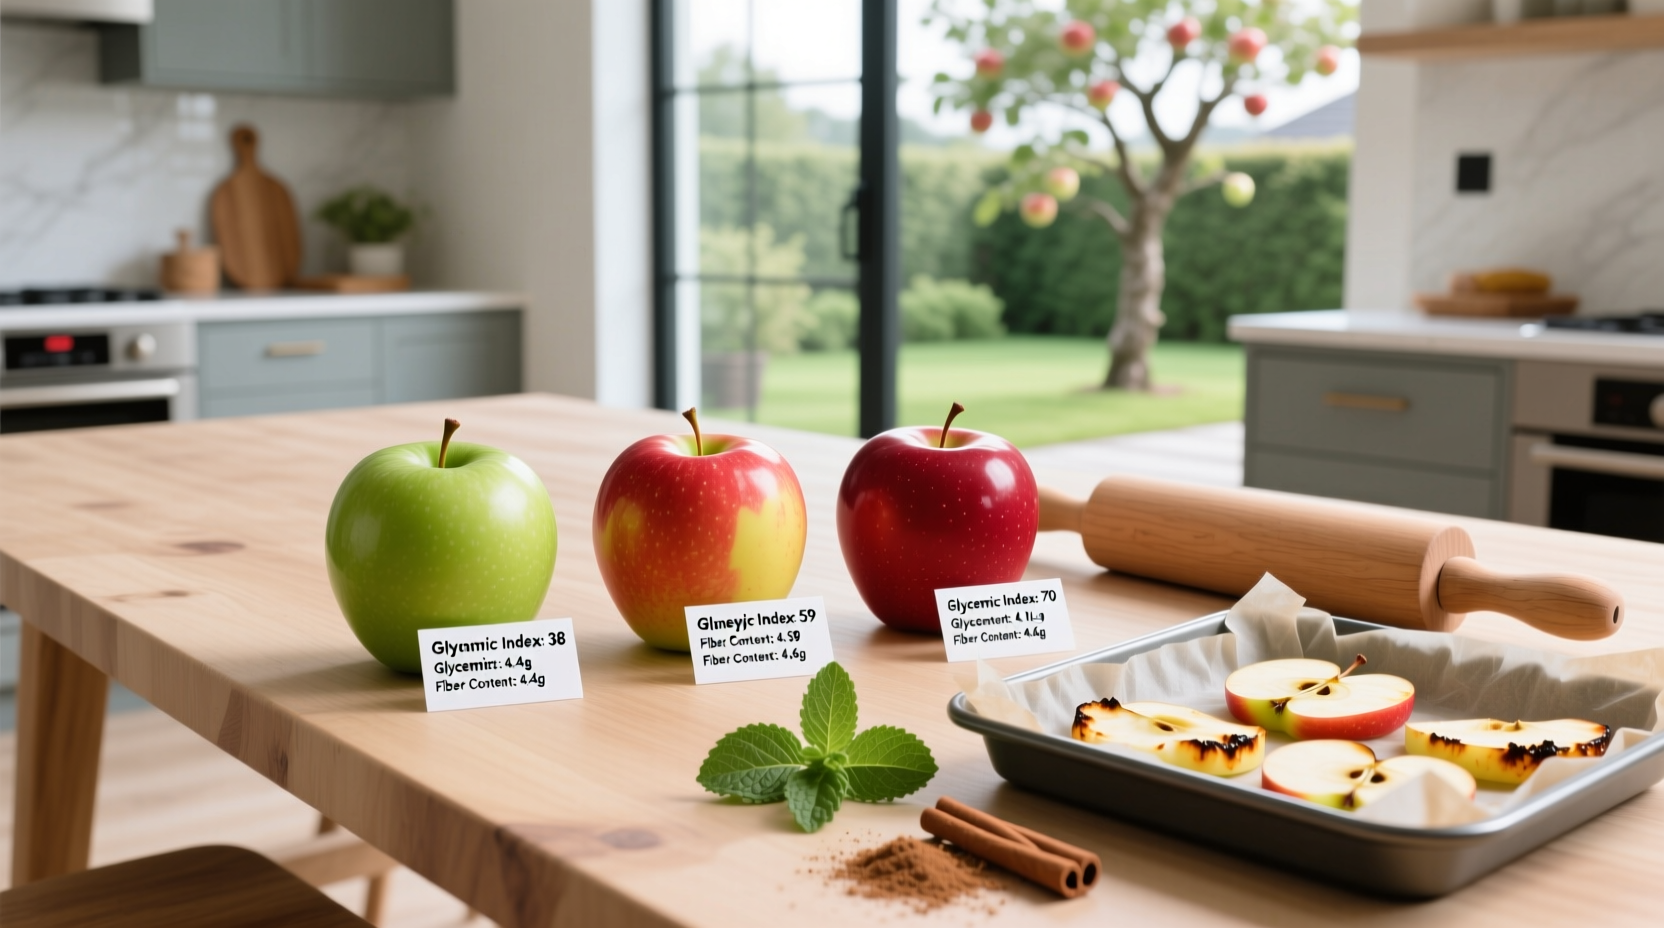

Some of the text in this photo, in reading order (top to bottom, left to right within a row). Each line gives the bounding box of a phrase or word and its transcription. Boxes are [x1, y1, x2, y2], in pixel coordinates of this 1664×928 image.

[1003, 593, 1038, 606] Index:
[1041, 590, 1056, 602] 70
[799, 609, 816, 622] 59
[502, 634, 545, 649] Index:
[548, 632, 566, 645] 38
[703, 655, 730, 666] Fiber
